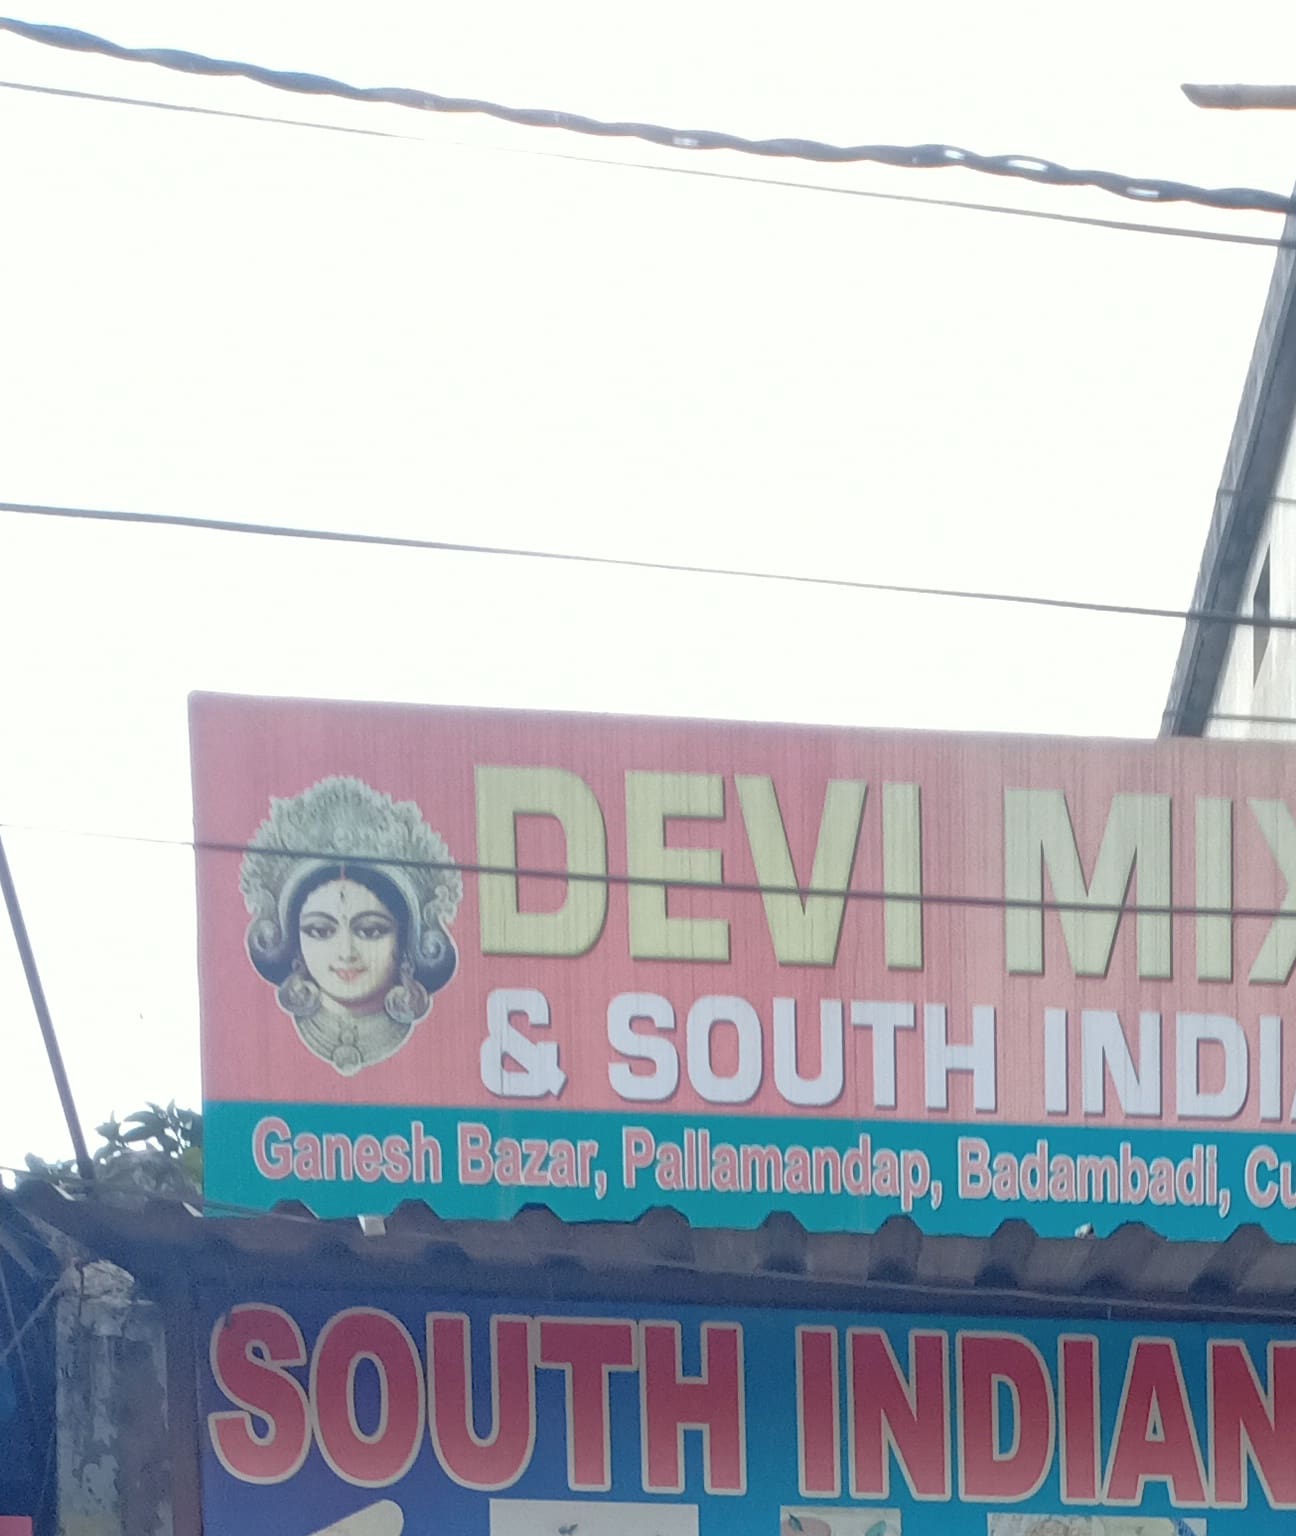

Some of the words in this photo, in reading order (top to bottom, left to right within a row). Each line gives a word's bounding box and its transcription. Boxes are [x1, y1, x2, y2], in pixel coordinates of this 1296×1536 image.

[473, 764, 924, 973] DEVI
[480, 988, 568, 1097] &
[607, 992, 999, 1114] SOUTH
[252, 1116, 442, 1185] Ganesh
[457, 1121, 607, 1199] Bazar,
[621, 1126, 942, 1212] Pallamandap,
[958, 1136, 1230, 1217] Badambadi,
[207, 1302, 747, 1496] SOUTH
